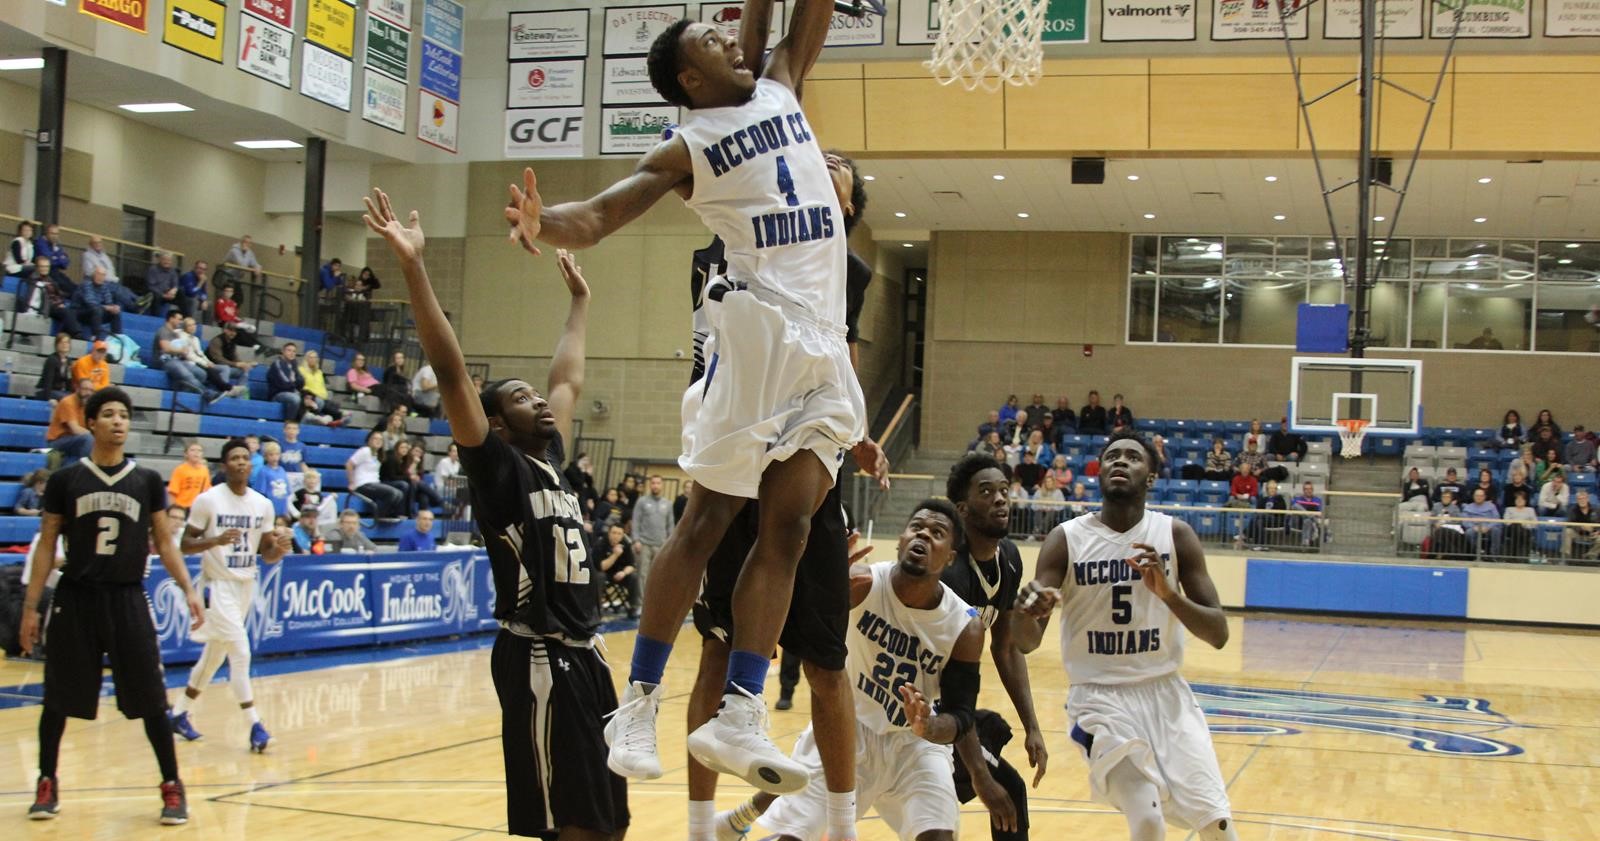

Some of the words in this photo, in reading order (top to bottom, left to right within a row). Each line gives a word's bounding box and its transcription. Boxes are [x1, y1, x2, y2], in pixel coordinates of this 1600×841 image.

[180, 10, 216, 37] Parker
[612, 18, 620, 28] D
[828, 13, 873, 29] RSONS
[1108, 4, 1171, 16] valmont
[1452, 11, 1510, 22] PLUMBING
[263, 27, 282, 41] FIRST
[514, 30, 557, 42] Gateway
[259, 49, 277, 66] BANK
[305, 64, 349, 92] CLEANERS
[510, 116, 583, 143] GCF
[612, 114, 641, 128] Lawn
[643, 113, 671, 128] Care
[703, 115, 789, 178] MCCOOK
[786, 112, 811, 144] CC
[776, 155, 800, 207] 4
[752, 206, 834, 249] INDIANS
[95, 516, 120, 555] 2
[552, 524, 590, 585] 12
[413, 574, 424, 583] OF
[425, 572, 440, 582] THE
[283, 573, 373, 620] McCook
[382, 582, 442, 623] Indians
[1111, 586, 1133, 625] 5
[287, 618, 331, 631] COMMUNITY
[333, 616, 367, 628] COLLEGE
[856, 610, 921, 662] MCCOOK
[919, 647, 943, 675] CC
[1087, 628, 1160, 655] INDIANS
[872, 653, 918, 701] 22
[857, 672, 912, 728] INDIAN
